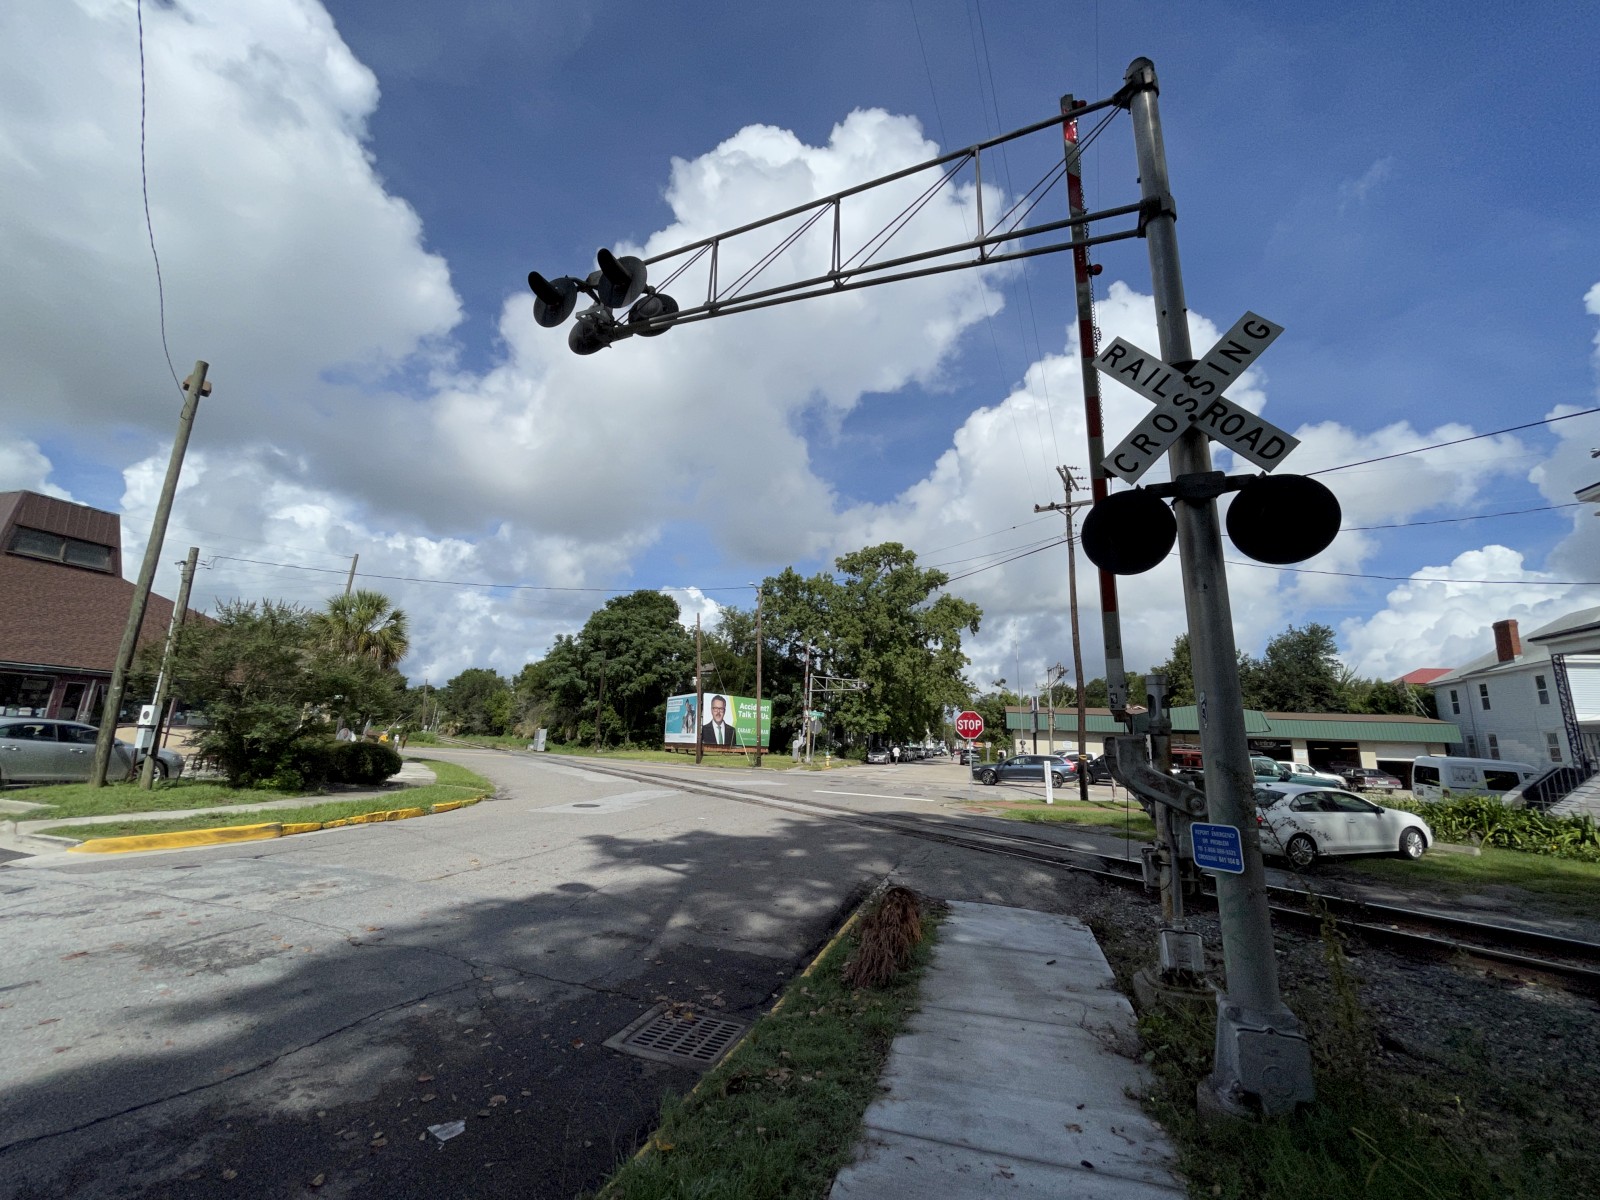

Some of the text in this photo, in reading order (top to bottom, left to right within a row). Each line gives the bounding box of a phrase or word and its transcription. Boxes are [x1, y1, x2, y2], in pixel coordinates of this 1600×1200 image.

[1114, 320, 1271, 473] CROSSING
[740, 702, 770, 712] Accidnt?
[958, 720, 981, 730] STOP
